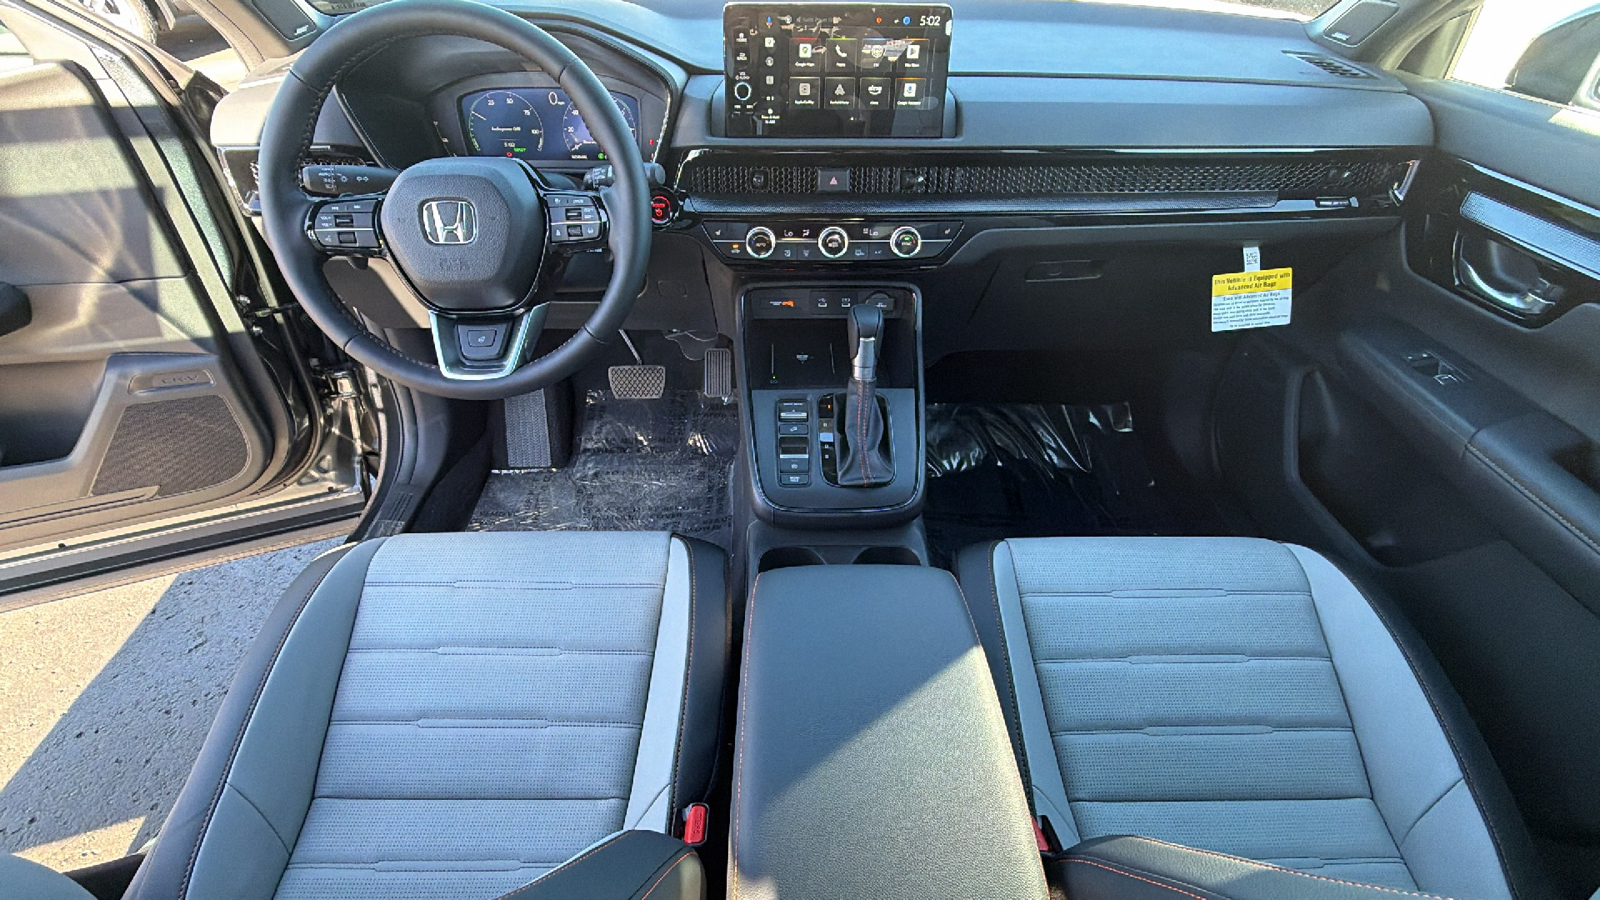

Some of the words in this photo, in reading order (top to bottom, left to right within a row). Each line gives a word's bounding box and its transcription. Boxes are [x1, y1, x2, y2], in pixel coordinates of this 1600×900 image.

[919, 15, 941, 26] 5:02
[548, 91, 558, 106] 0
[784, 229, 794, 237] Lo
[1253, 273, 1278, 281] Equipped
[1228, 283, 1253, 291] Advanced
[1254, 281, 1263, 289] Air
